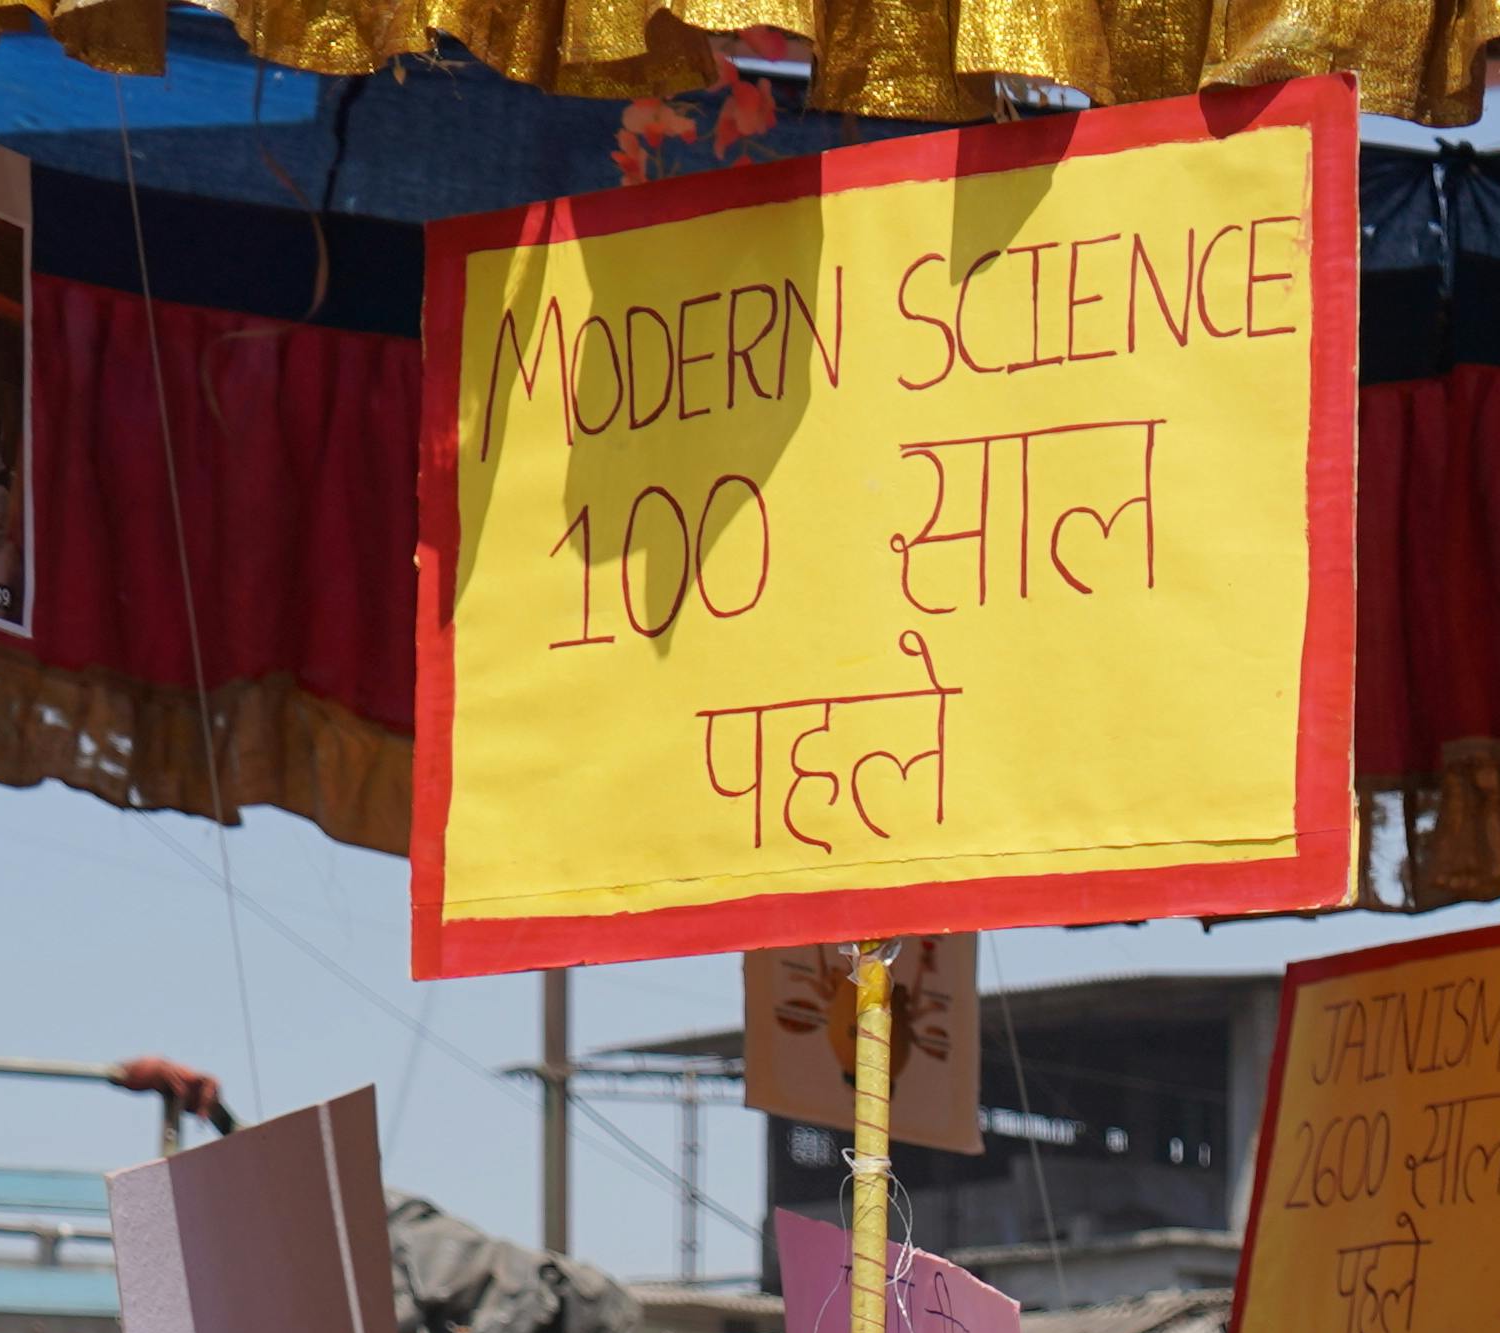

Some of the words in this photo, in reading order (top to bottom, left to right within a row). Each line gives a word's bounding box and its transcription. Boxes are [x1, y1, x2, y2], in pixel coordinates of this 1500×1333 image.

[479, 265, 844, 463] MODERN
[897, 214, 1302, 390] SCIENCE
[549, 472, 771, 649] 100
[889, 417, 1167, 615] साल
[696, 629, 964, 854] पहले
[1284, 1110, 1391, 1210] 2600
